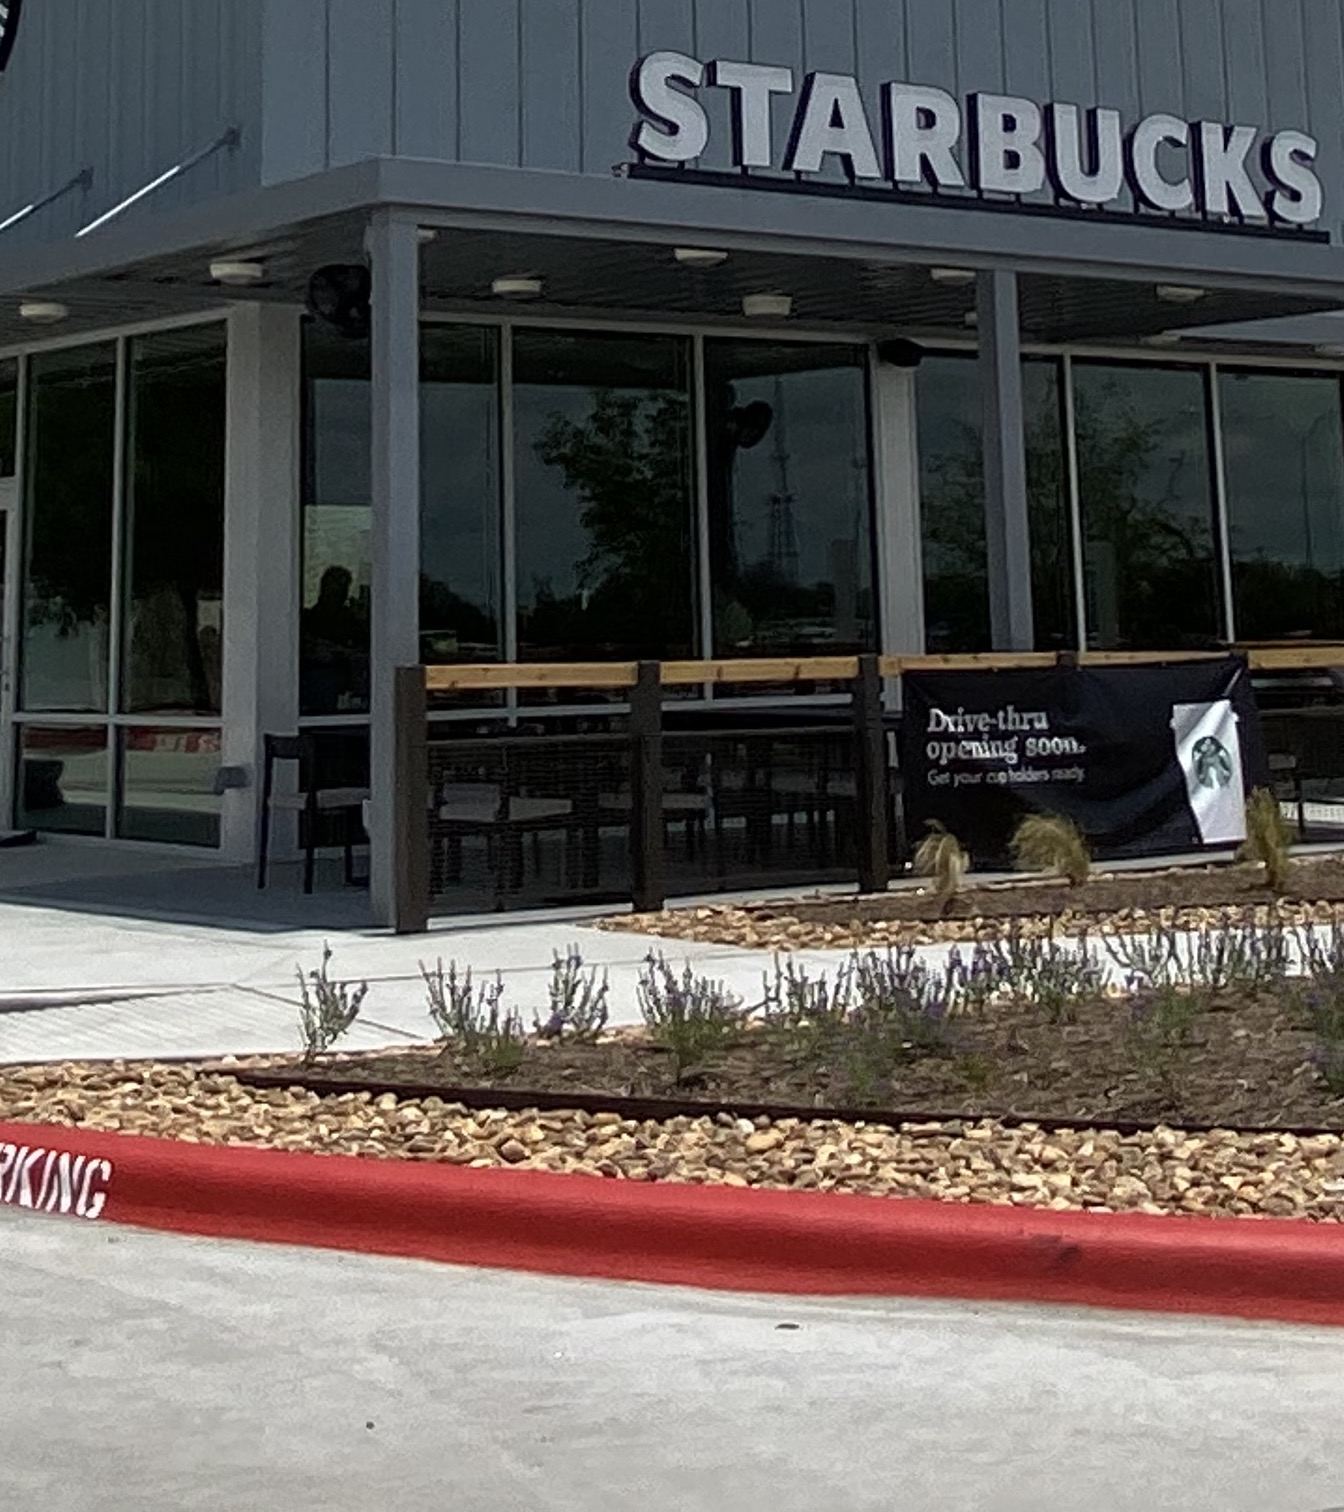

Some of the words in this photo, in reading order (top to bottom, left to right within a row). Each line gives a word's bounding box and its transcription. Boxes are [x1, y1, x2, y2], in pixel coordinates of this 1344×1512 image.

[630, 50, 1322, 223] STARBUCKS
[927, 705, 1049, 732] Drive-thru
[926, 734, 1018, 765] opening
[1025, 736, 1086, 757] soon.
[927, 769, 950, 786] Get
[954, 772, 983, 786] your
